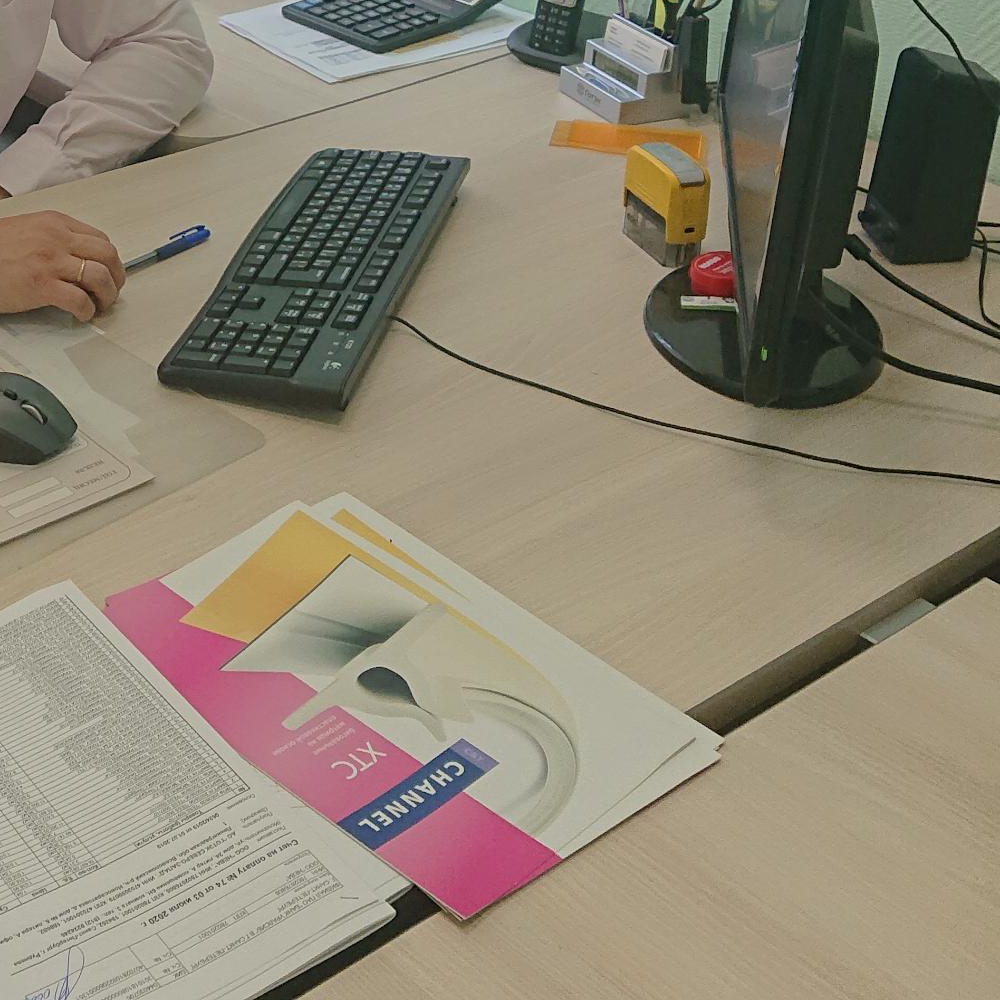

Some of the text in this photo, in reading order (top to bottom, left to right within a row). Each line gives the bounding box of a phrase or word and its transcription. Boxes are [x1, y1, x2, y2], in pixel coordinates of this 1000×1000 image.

[358, 761, 465, 832] CHANNEL
[277, 837, 298, 853] Счет
[235, 854, 267, 875] оплату
[167, 896, 192, 913] июля
[147, 909, 168, 925] 2020
